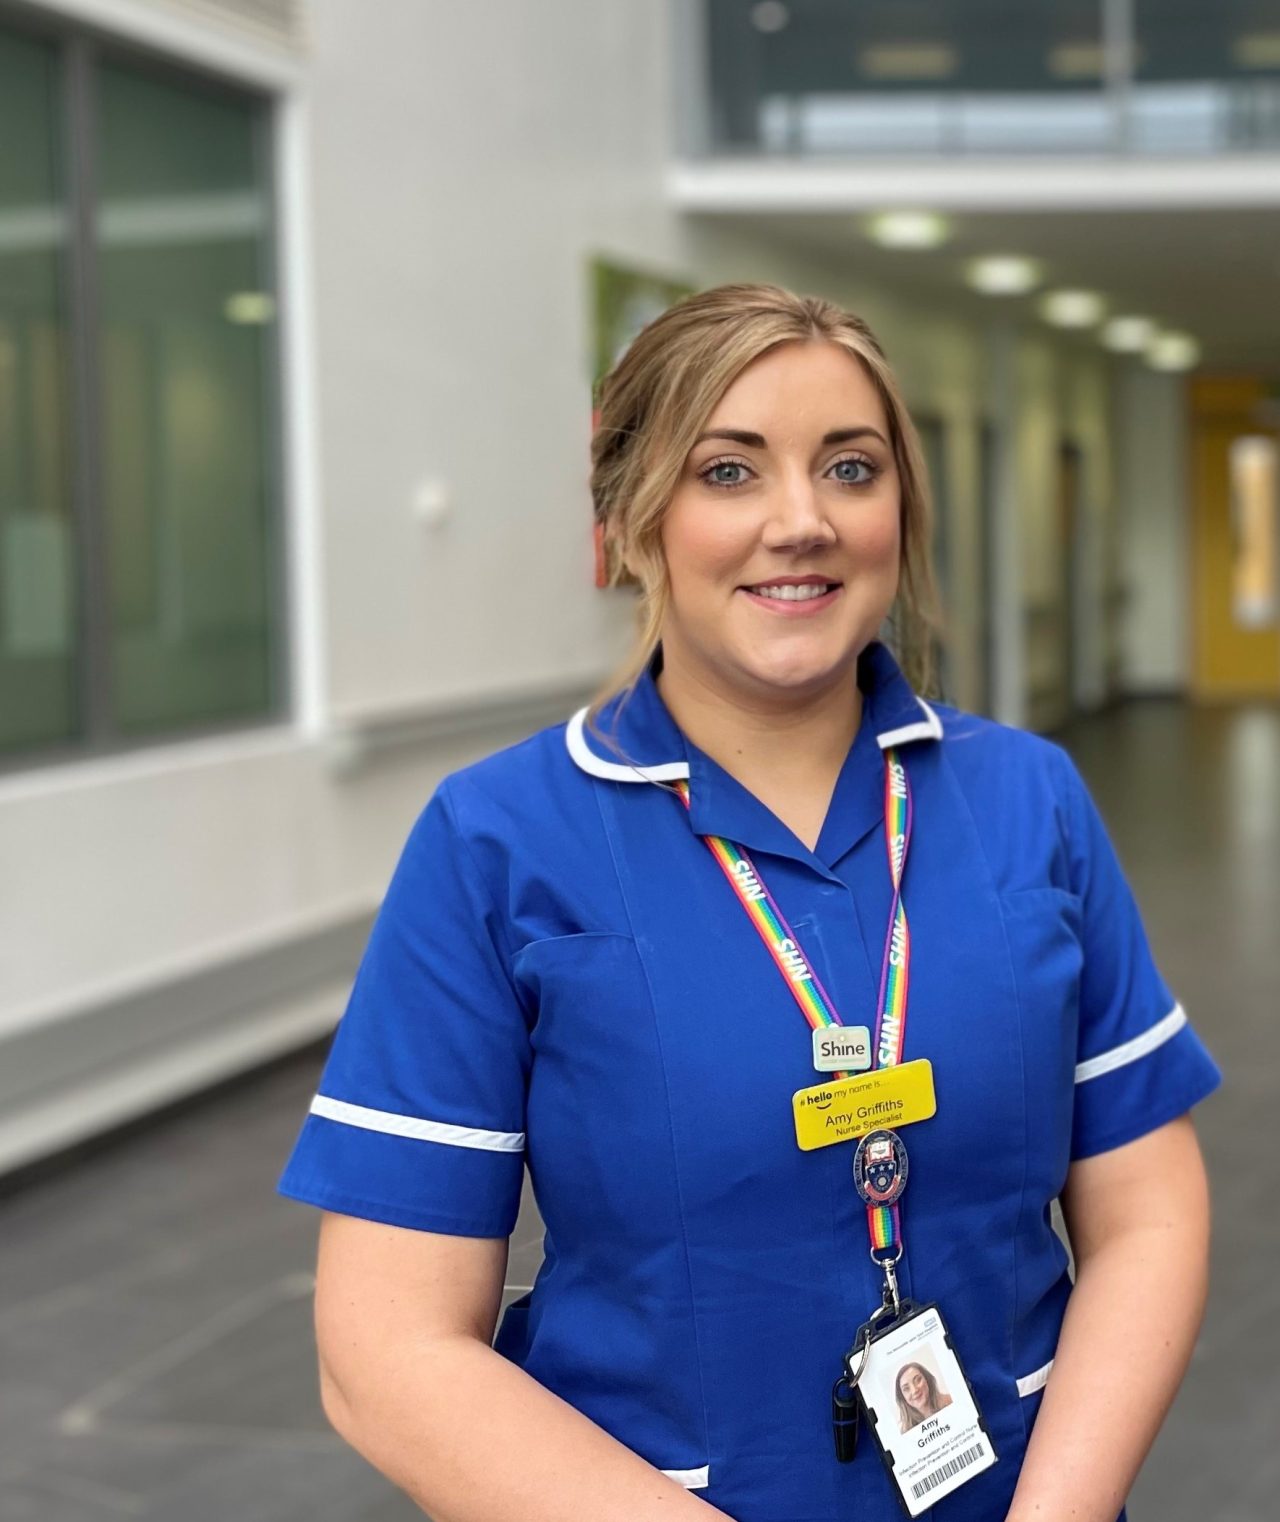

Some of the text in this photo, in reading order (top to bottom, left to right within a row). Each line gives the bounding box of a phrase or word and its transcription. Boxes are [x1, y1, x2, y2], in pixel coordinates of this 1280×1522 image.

[728, 860, 766, 901] NHS
[889, 919, 906, 969] NHS
[775, 938, 812, 981] NHS
[821, 1041, 865, 1056] Shine
[878, 1013, 901, 1067] NHS
[834, 1089, 847, 1098] my
[849, 1082, 873, 1094] name
[825, 1099, 904, 1127] Amy Griffiths
[836, 1112, 903, 1136] Nurse Specialist
[917, 1424, 951, 1448] Griffiths
[921, 1417, 939, 1433] Amy
